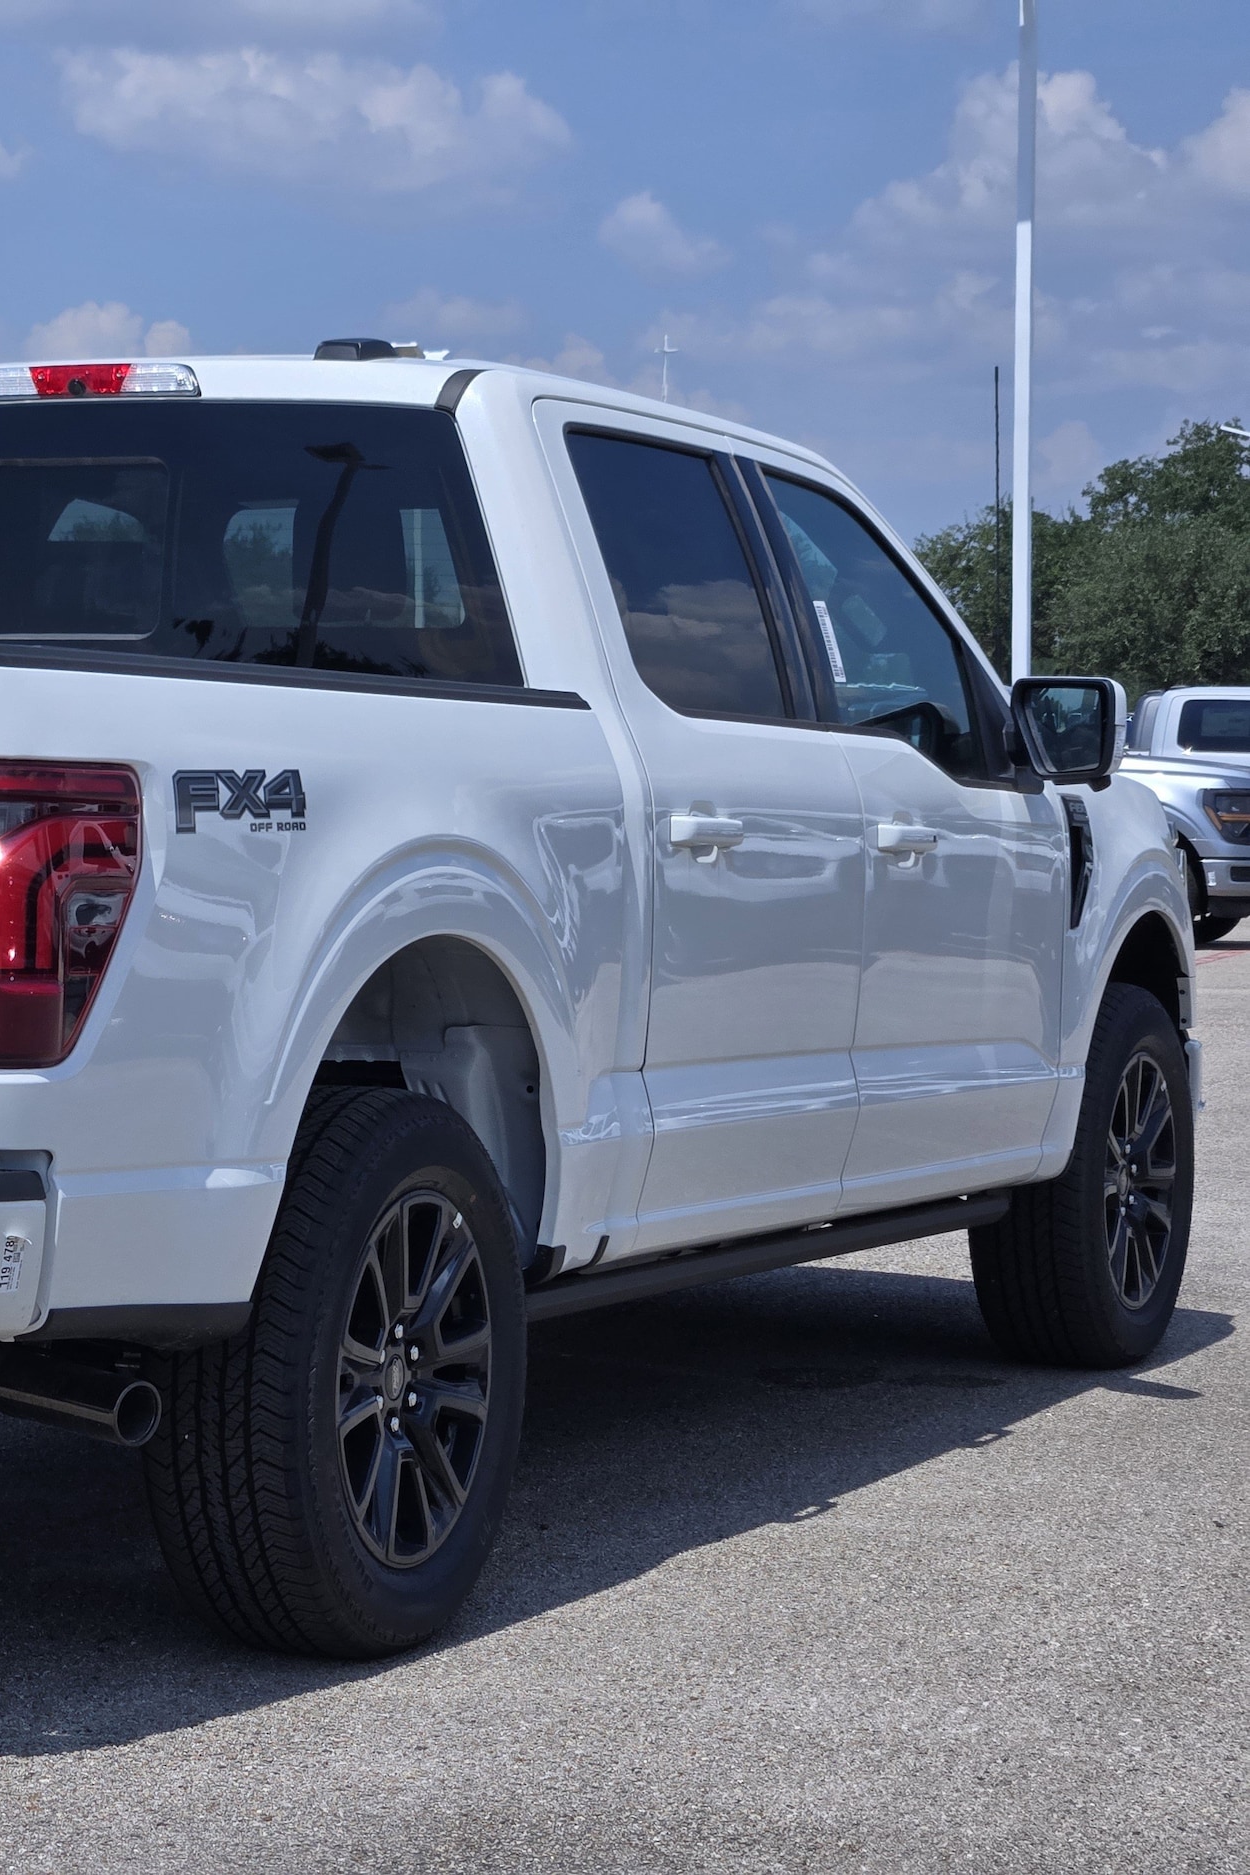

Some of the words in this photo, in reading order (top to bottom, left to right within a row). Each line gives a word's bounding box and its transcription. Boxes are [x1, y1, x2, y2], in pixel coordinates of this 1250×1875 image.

[172, 769, 306, 834] FX4
[250, 822, 273, 833] OFF
[276, 821, 307, 832] ROAD
[0, 1266, 11, 1288] 119
